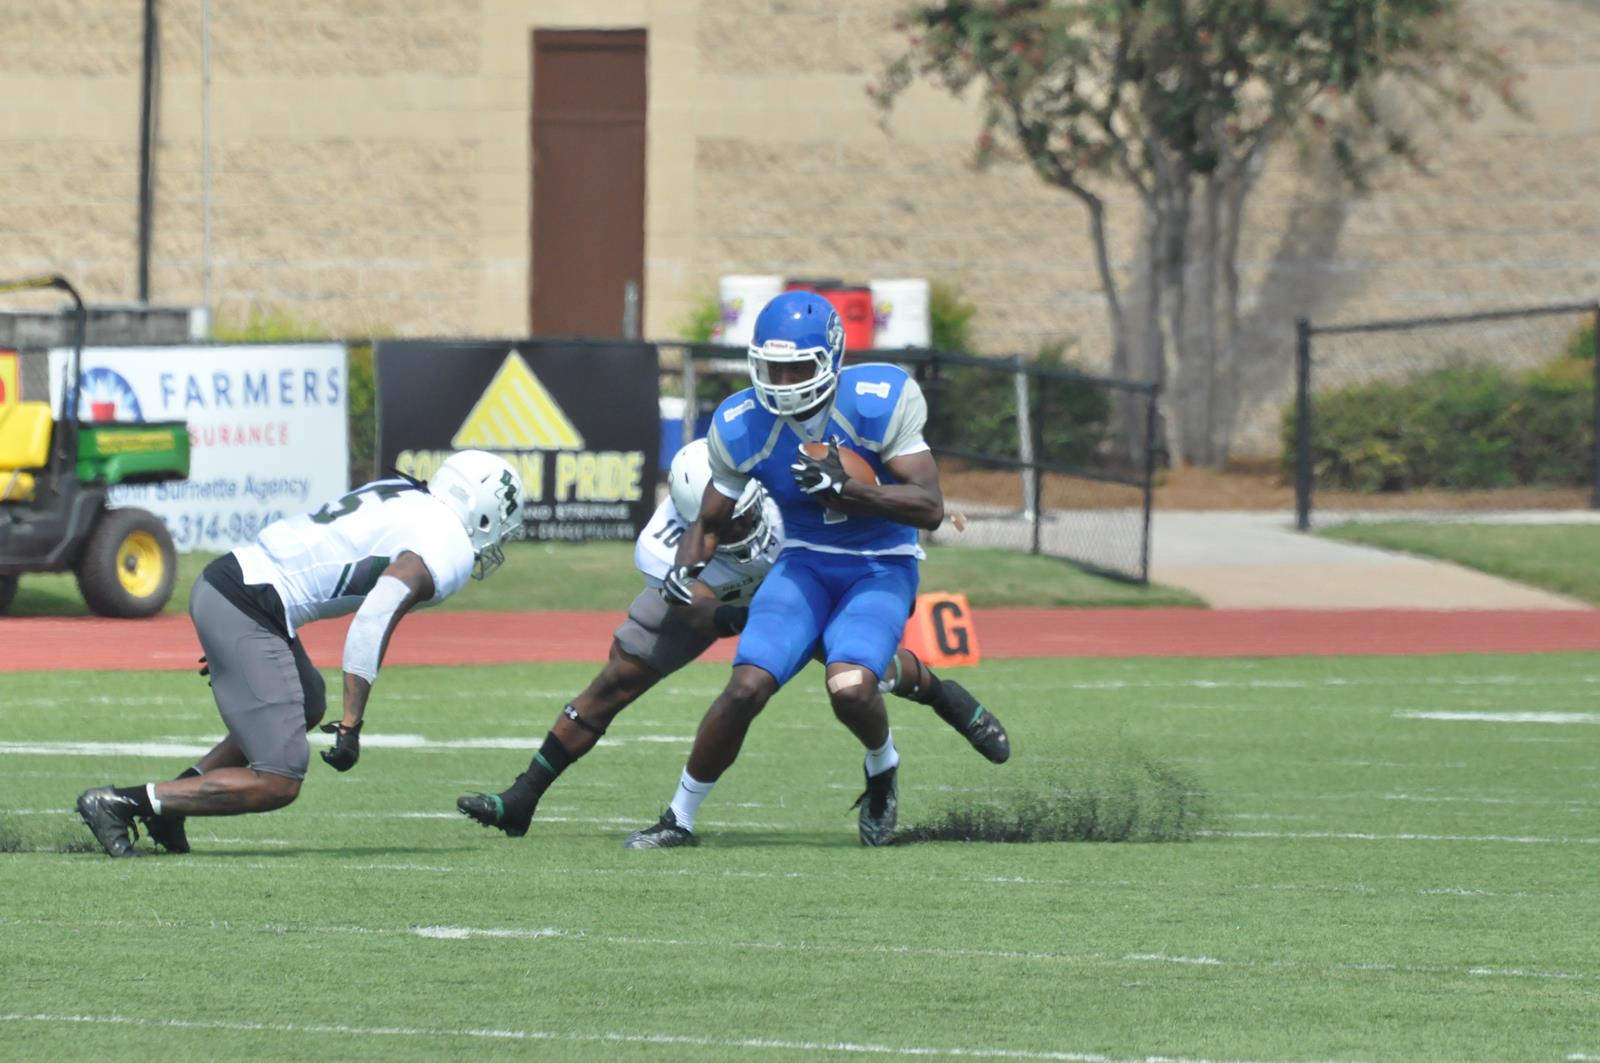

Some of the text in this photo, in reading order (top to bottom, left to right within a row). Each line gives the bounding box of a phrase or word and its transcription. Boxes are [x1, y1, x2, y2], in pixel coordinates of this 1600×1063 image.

[159, 368, 340, 408] FARMERS
[856, 381, 891, 399] 1
[723, 399, 756, 423] 1
[190, 421, 288, 449] SURANCE
[244, 474, 310, 504] Agency
[555, 451, 644, 502] PRIDE
[932, 600, 970, 657] G
